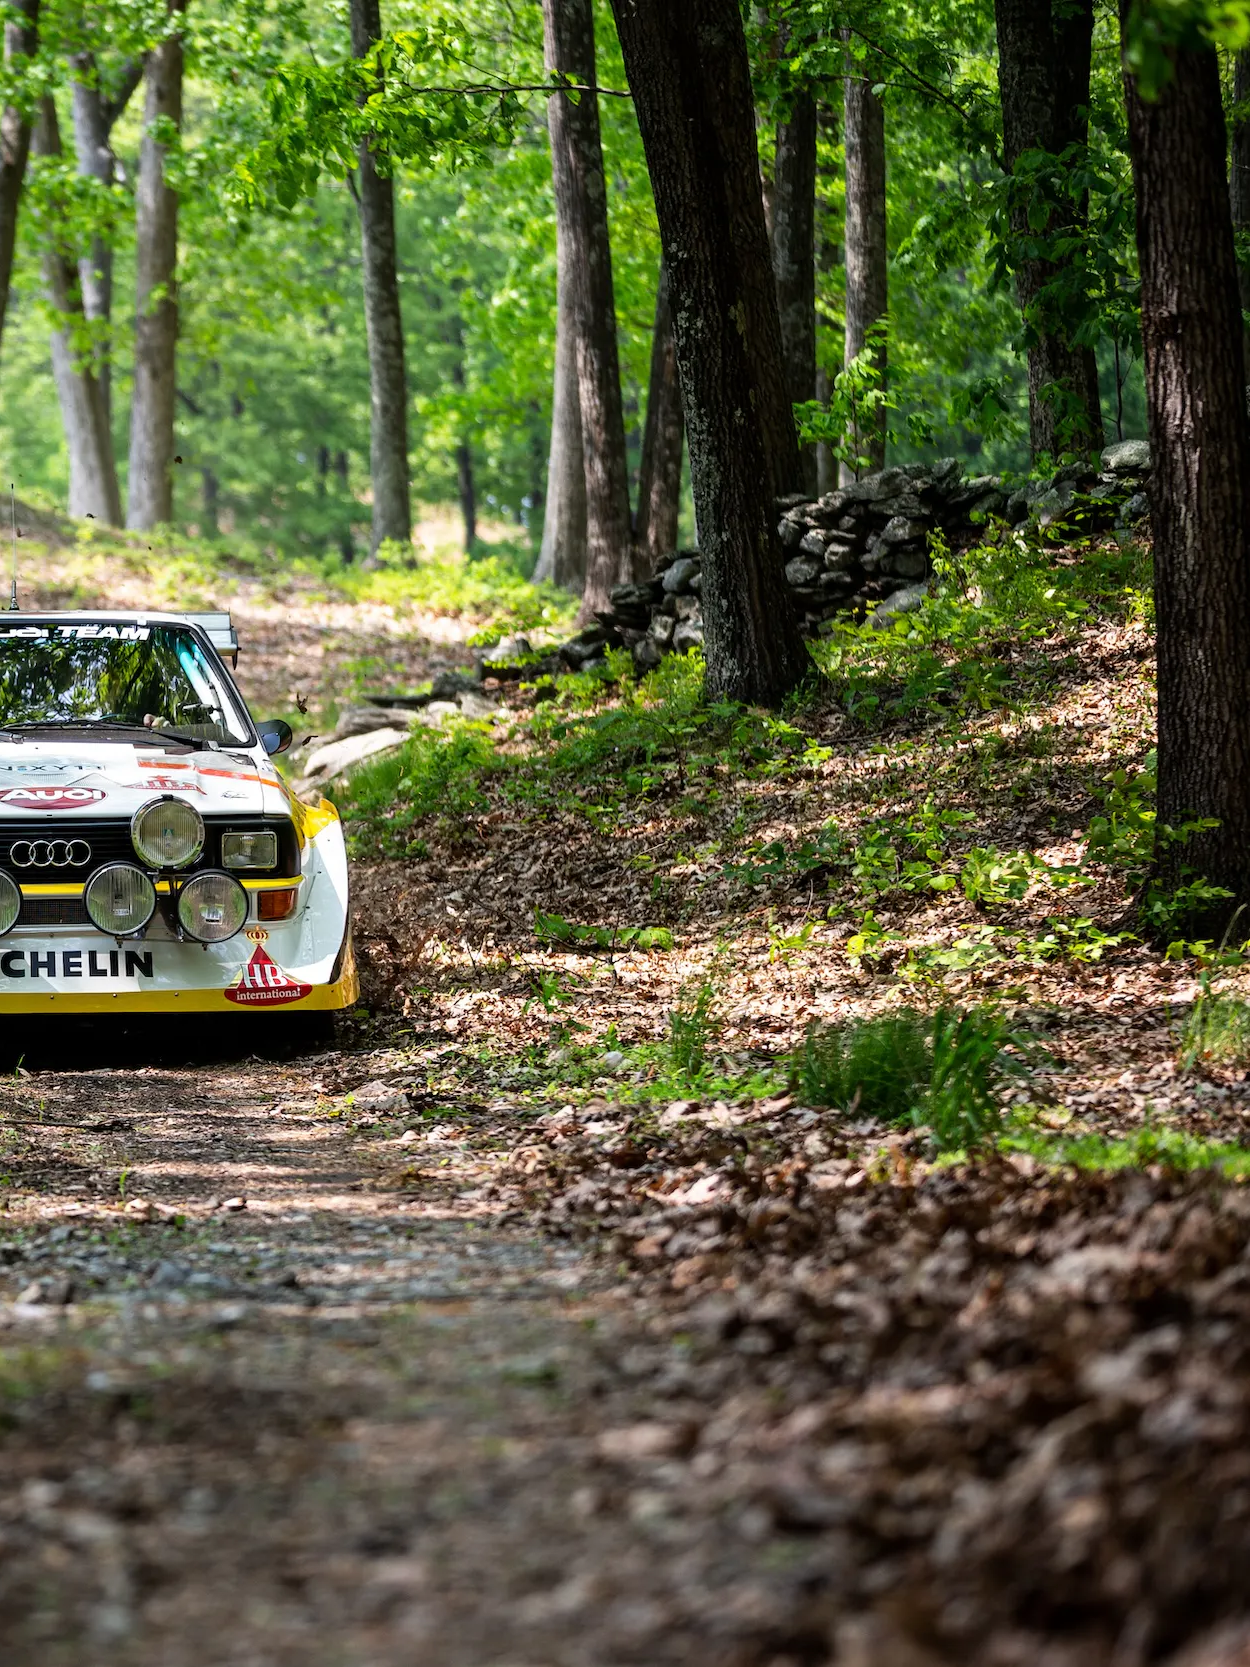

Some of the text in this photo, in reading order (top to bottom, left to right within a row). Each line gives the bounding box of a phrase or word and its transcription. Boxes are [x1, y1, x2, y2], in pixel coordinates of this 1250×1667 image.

[57, 625, 150, 641] TEAM
[239, 963, 288, 988] HB
[236, 986, 301, 1000] international
